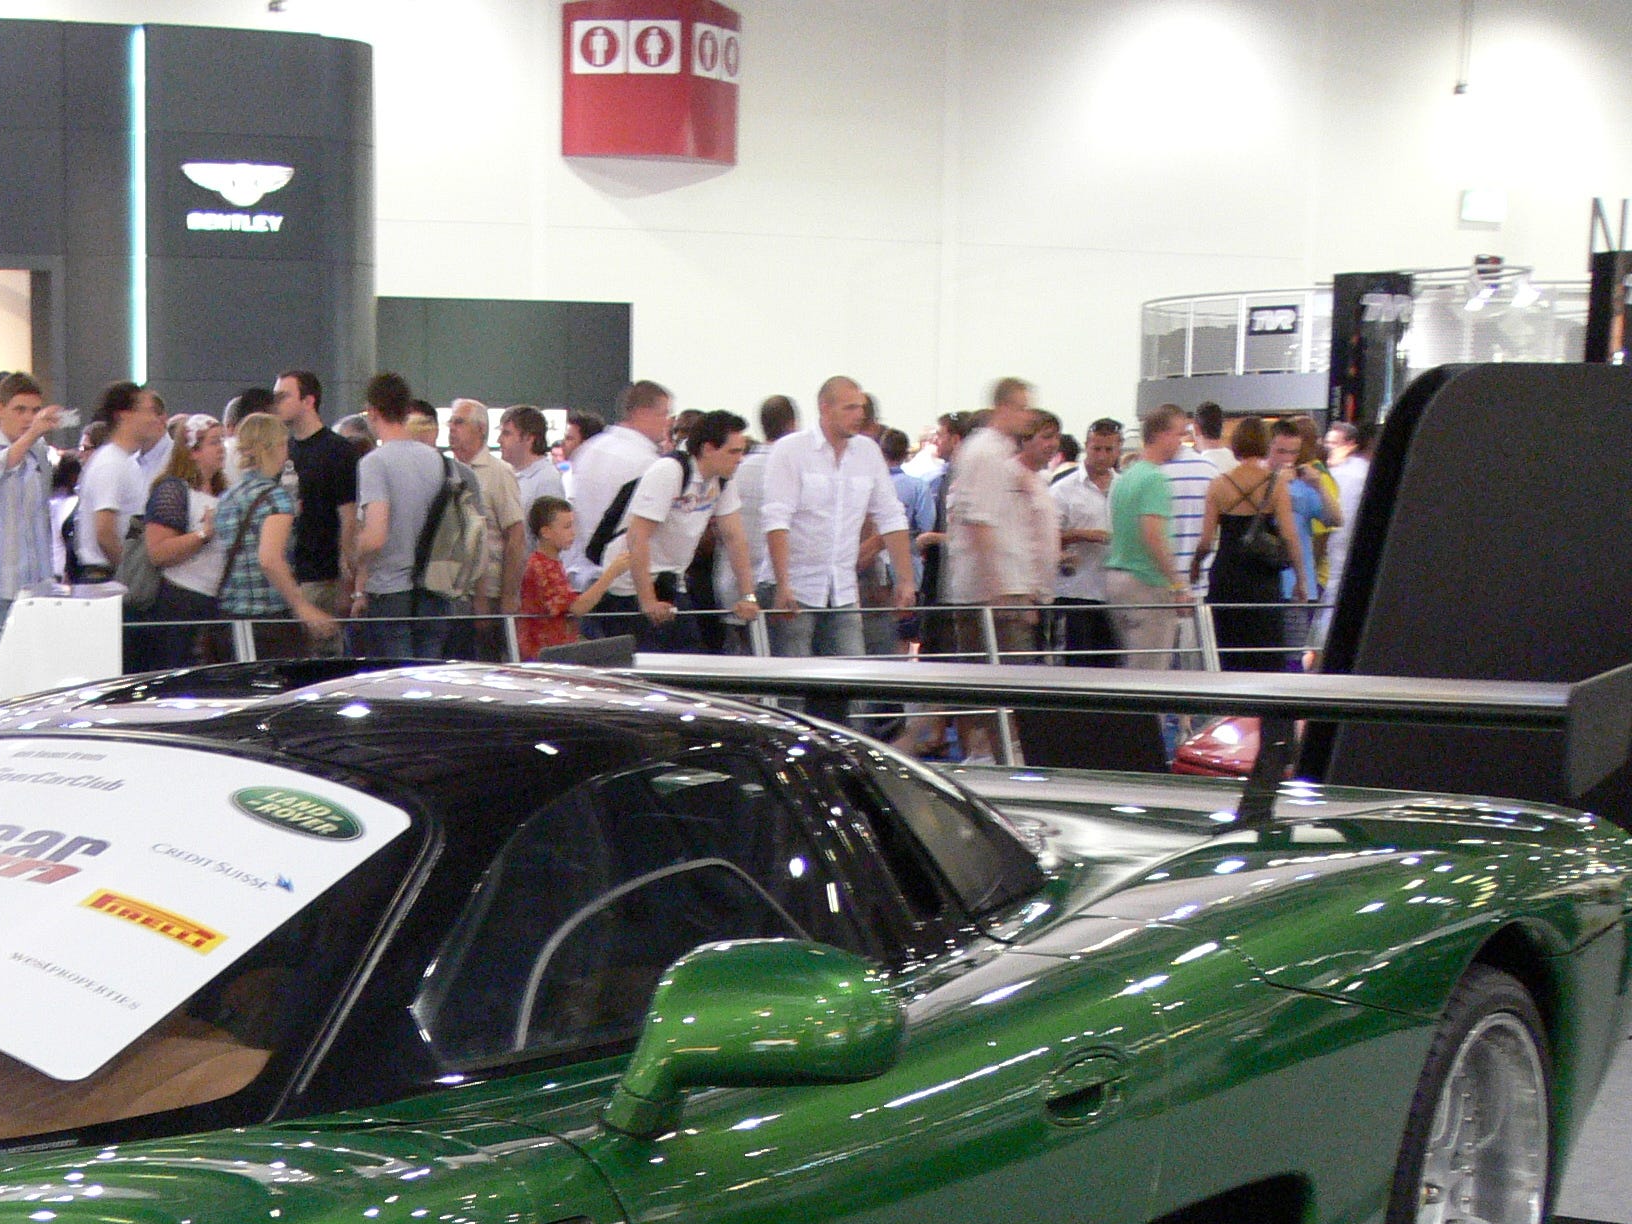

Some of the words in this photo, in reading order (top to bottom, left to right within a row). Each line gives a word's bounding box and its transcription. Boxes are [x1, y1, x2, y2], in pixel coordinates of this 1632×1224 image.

[152, 843, 213, 867] CREDIT
[215, 862, 270, 890] SUISSE
[88, 893, 216, 948] PIRELLI
